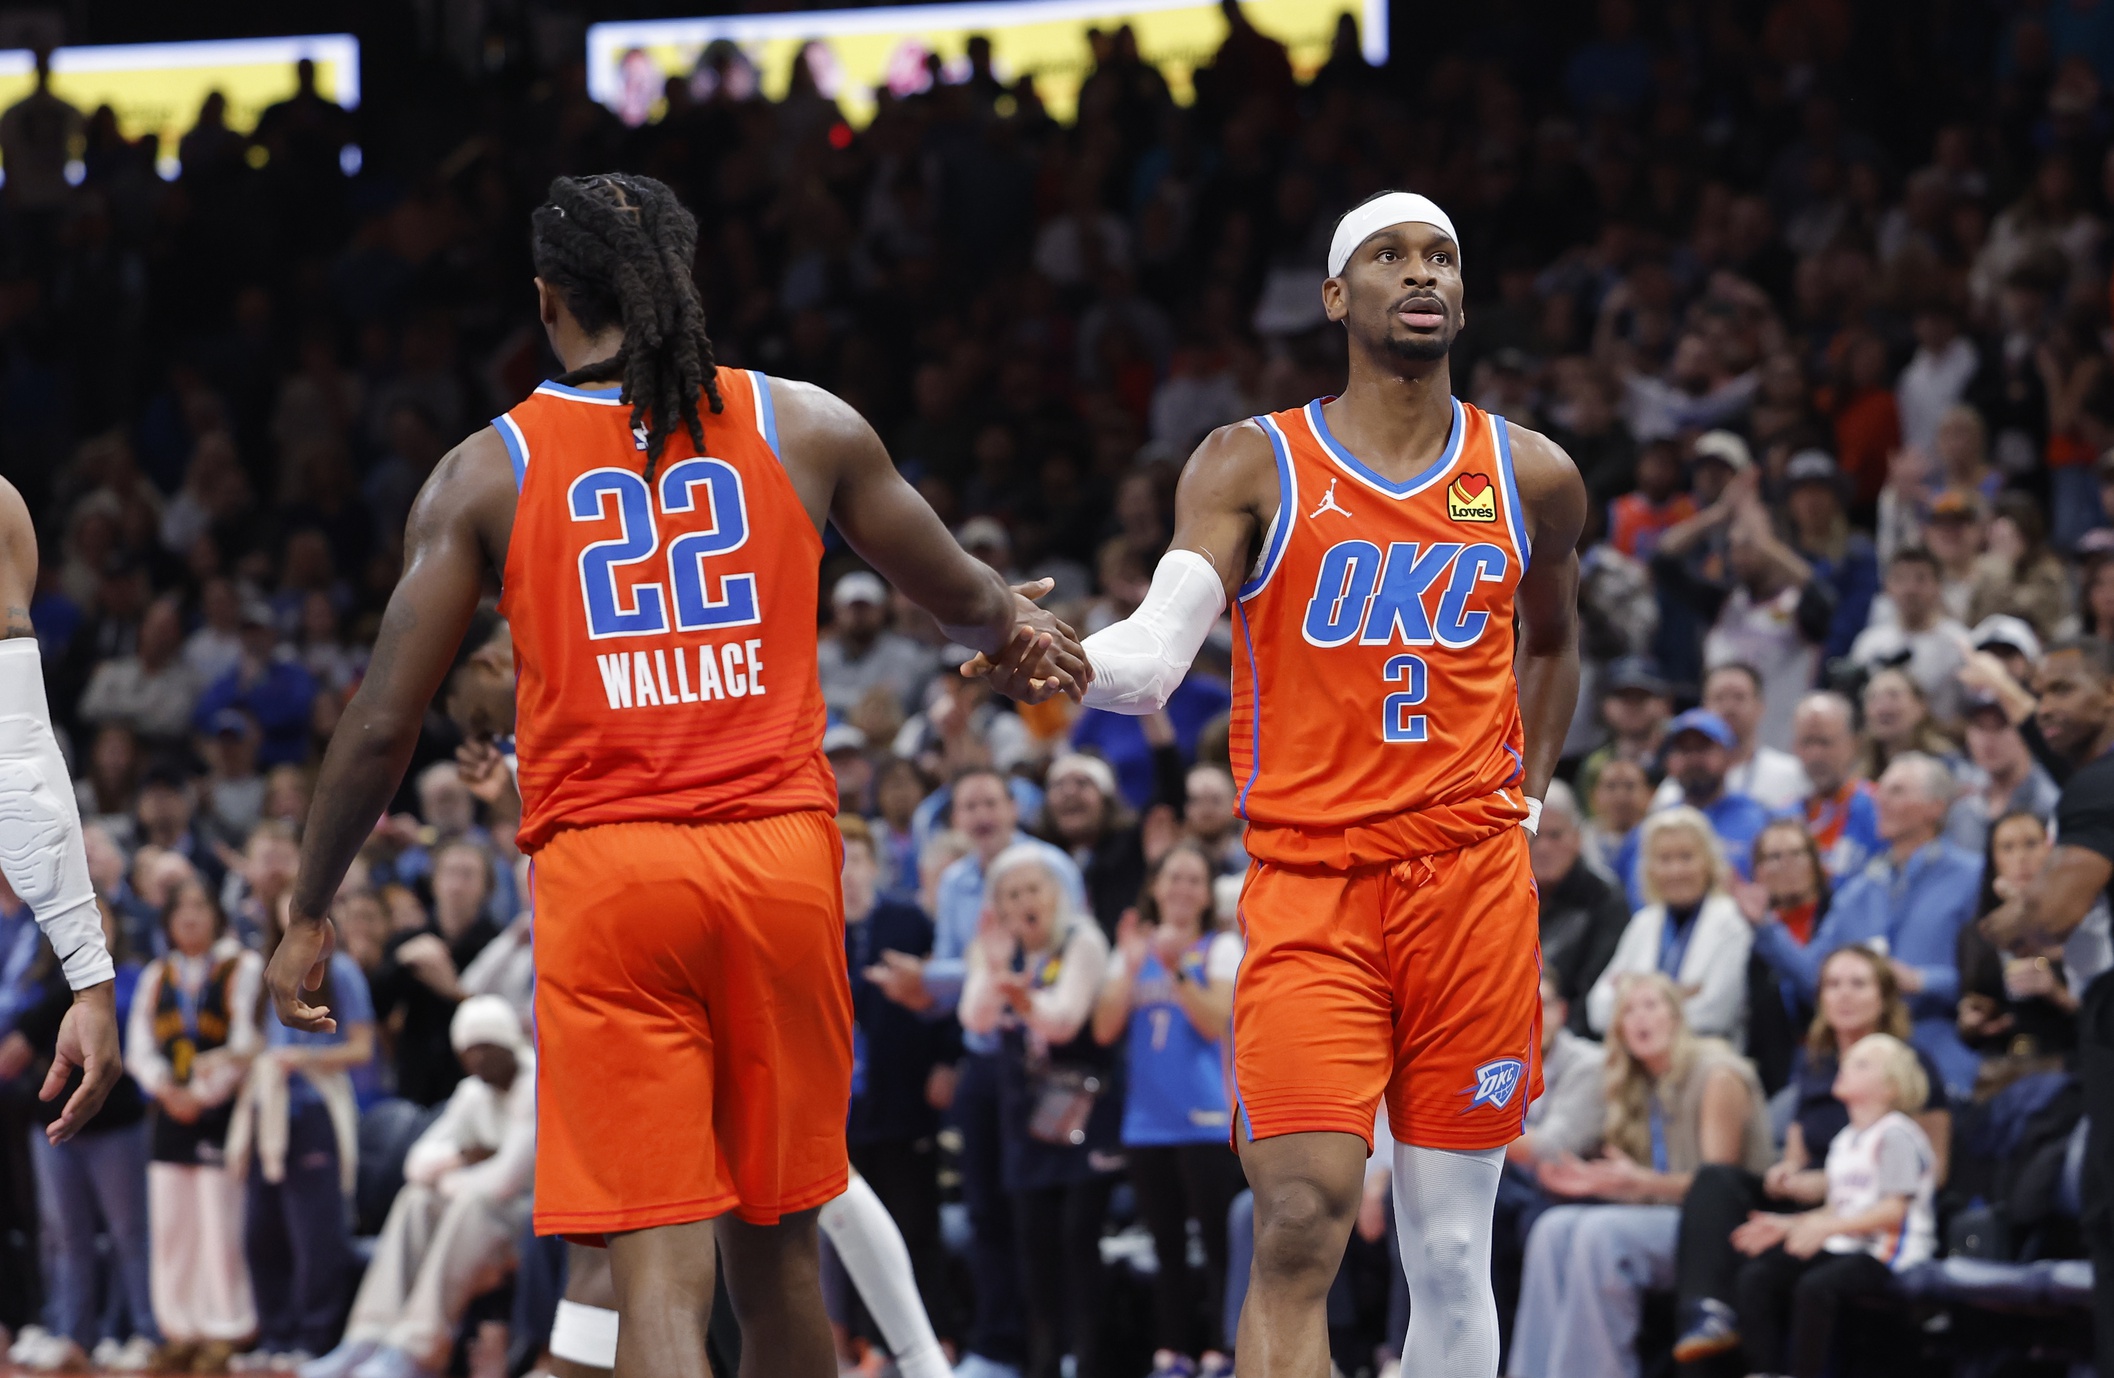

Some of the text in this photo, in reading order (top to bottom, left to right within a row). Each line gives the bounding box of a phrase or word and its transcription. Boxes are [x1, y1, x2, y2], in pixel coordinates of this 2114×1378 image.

[567, 456, 762, 641] 22
[1301, 539, 1508, 649] OKC
[596, 638, 766, 710] WALLACE
[1382, 653, 1429, 743] 2
[1474, 1066, 1515, 1101] OKC
